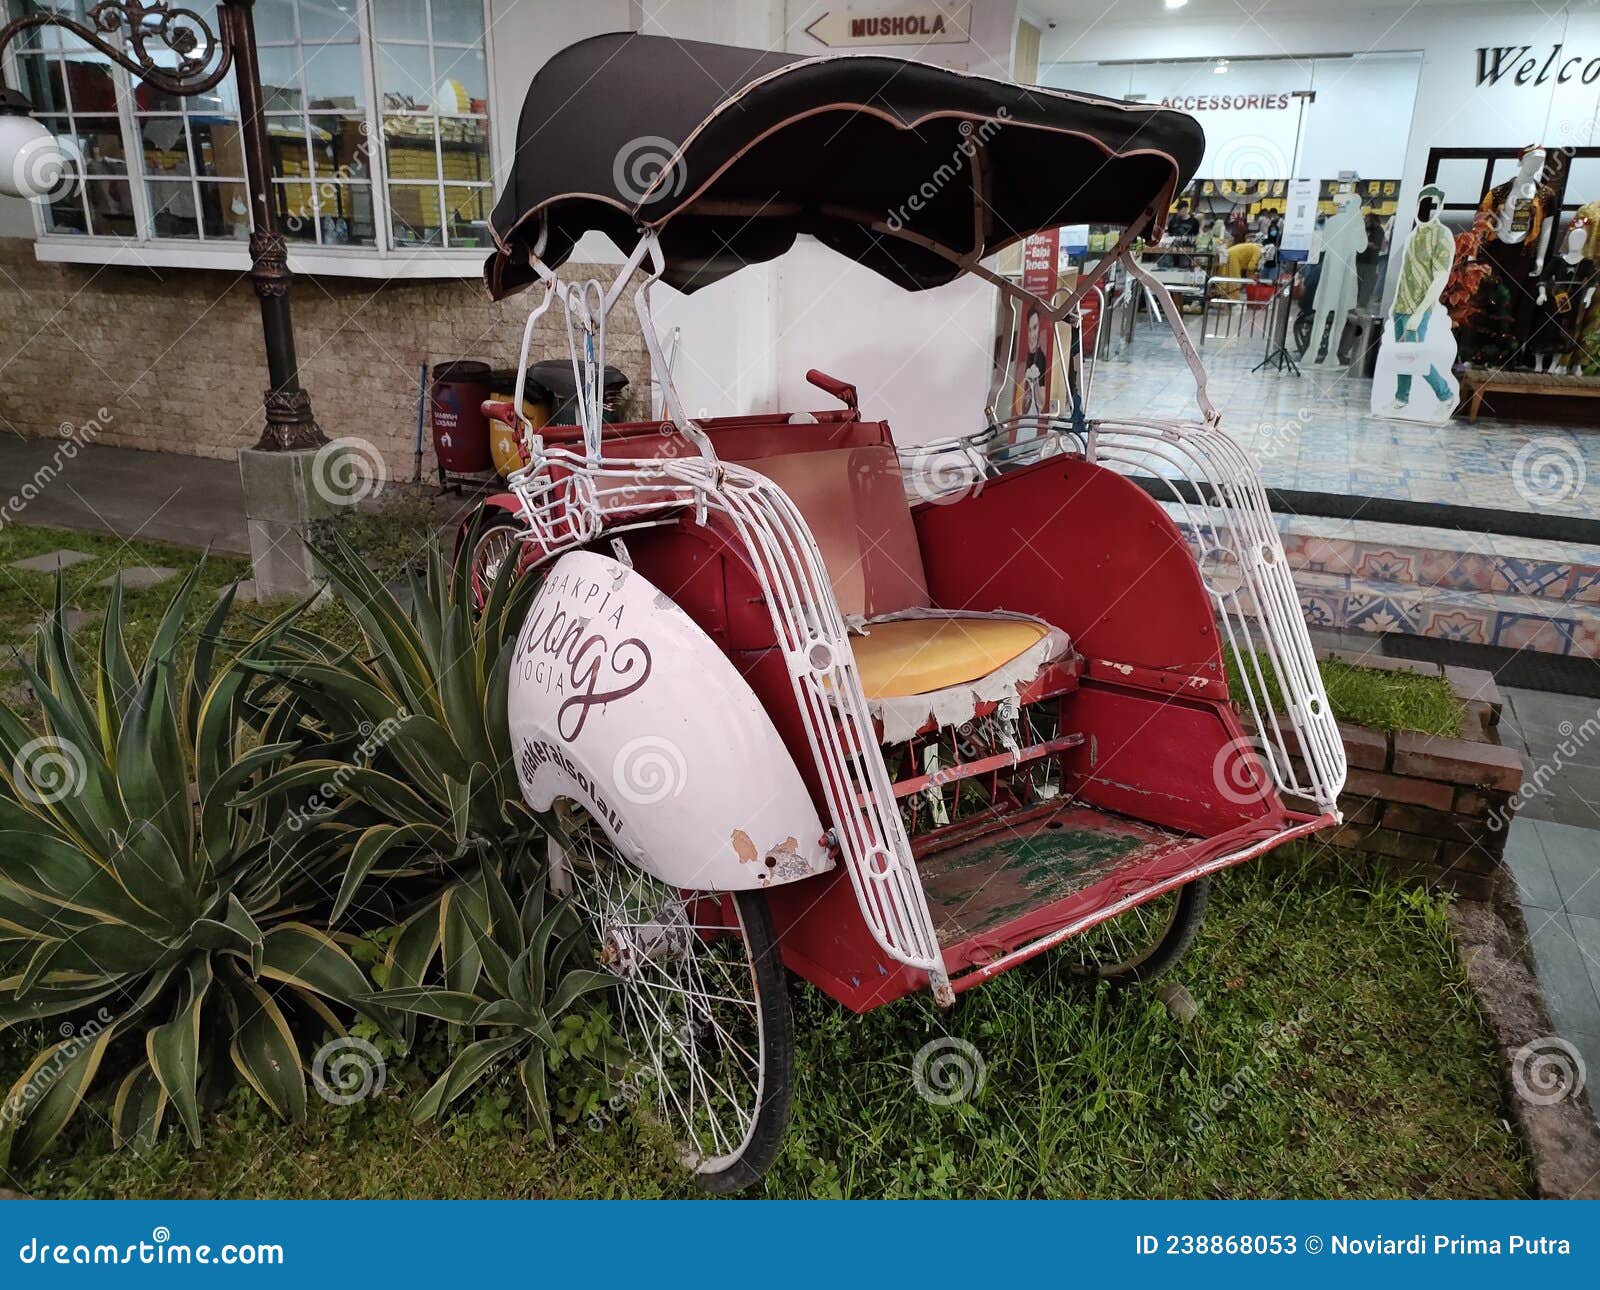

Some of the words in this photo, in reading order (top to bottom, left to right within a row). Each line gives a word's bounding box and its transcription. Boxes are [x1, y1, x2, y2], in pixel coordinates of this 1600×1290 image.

[851, 14, 946, 38] MUSHOLA
[1474, 43, 1600, 88] Welco
[1160, 93, 1289, 111] ACCESSORIES
[547, 573, 625, 630] BAKPIA
[517, 659, 564, 697] JOGJA
